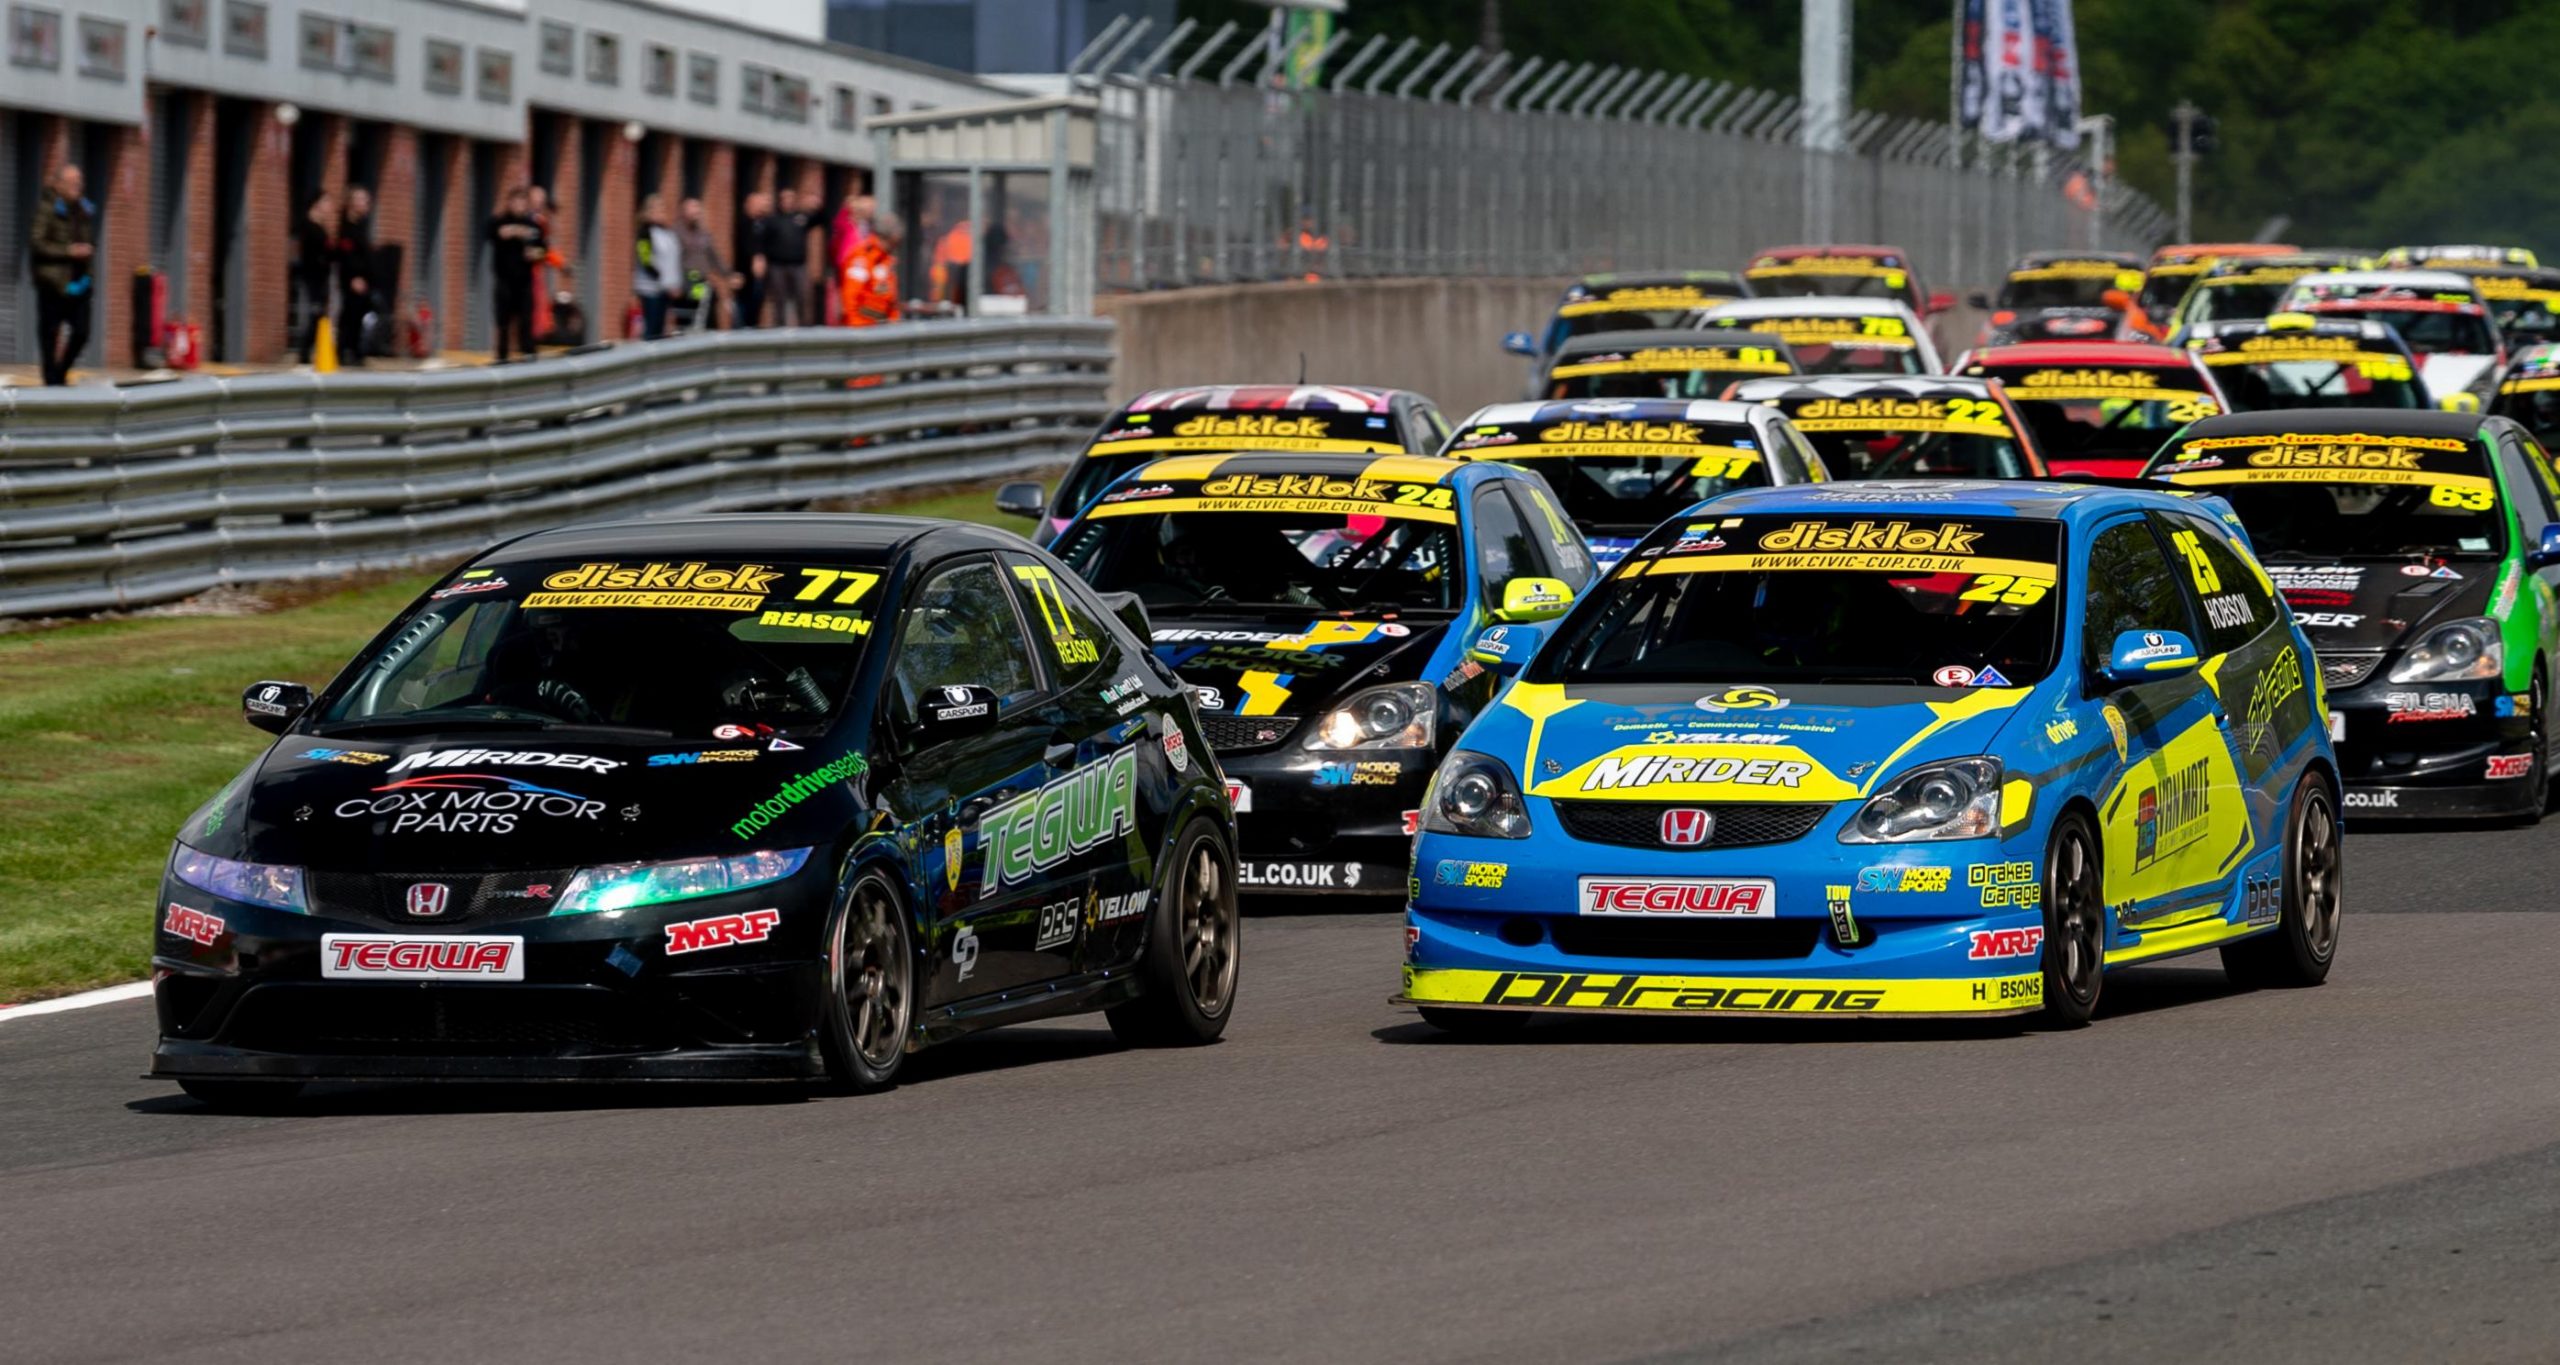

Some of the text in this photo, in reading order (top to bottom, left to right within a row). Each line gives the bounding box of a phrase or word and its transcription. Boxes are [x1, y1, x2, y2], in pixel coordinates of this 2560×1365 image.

[2021, 368, 2161, 388] disklok
[1797, 399, 1948, 418] disklok
[1946, 398, 2003, 426] 22
[1174, 415, 1330, 438] disklok
[1540, 421, 1705, 444] disklok
[2248, 446, 2424, 470] disklok
[1201, 474, 1394, 501] disklok
[1393, 483, 1454, 510] 24
[2430, 485, 2495, 511] 63
[1198, 499, 1381, 514] WWW.CIVIC-CUP.CO.UK
[1758, 521, 1984, 555] disklok
[1750, 556, 1966, 572] WWW.CIVIC-CUP.CO.UK
[2172, 530, 2222, 594] 25
[543, 562, 785, 594] disklok
[795, 568, 880, 604] 77
[1959, 574, 2056, 606] 25
[529, 593, 761, 611] WWW.CIVIC-CUP.CO.UK
[1012, 565, 1076, 635] 77
[2204, 593, 2255, 630] HOBSON
[759, 611, 871, 636] REASON
[1056, 639, 1100, 665] REASON
[1674, 733, 1792, 744] YELLOW
[647, 752, 701, 766] SW
[2485, 753, 2534, 779] MRF
[1312, 761, 1402, 785] SW MOTOR
[1352, 773, 1397, 785] SPORTS
[335, 791, 607, 821] COX MOTOR
[731, 750, 869, 840] motordriveseats
[2342, 790, 2399, 807] .co.uk
[392, 813, 520, 834] PARTS
[977, 743, 1137, 900] TEGIWA
[1464, 874, 1503, 889] SPORTS
[1468, 862, 1509, 877] MOTOR
[1857, 866, 1952, 893] SW MOTOR
[1968, 861, 2034, 887] Drakes
[1586, 883, 1767, 915] TEGIWA
[1825, 885, 1852, 900] TOW
[1900, 879, 1948, 893] SPORTS
[1980, 884, 2041, 909] Garage
[1098, 889, 1151, 921] YELLOW
[164, 903, 224, 946] MRF
[665, 908, 780, 956] MRF
[327, 939, 515, 973] TEGIWA
[1968, 926, 2044, 960] MRF
